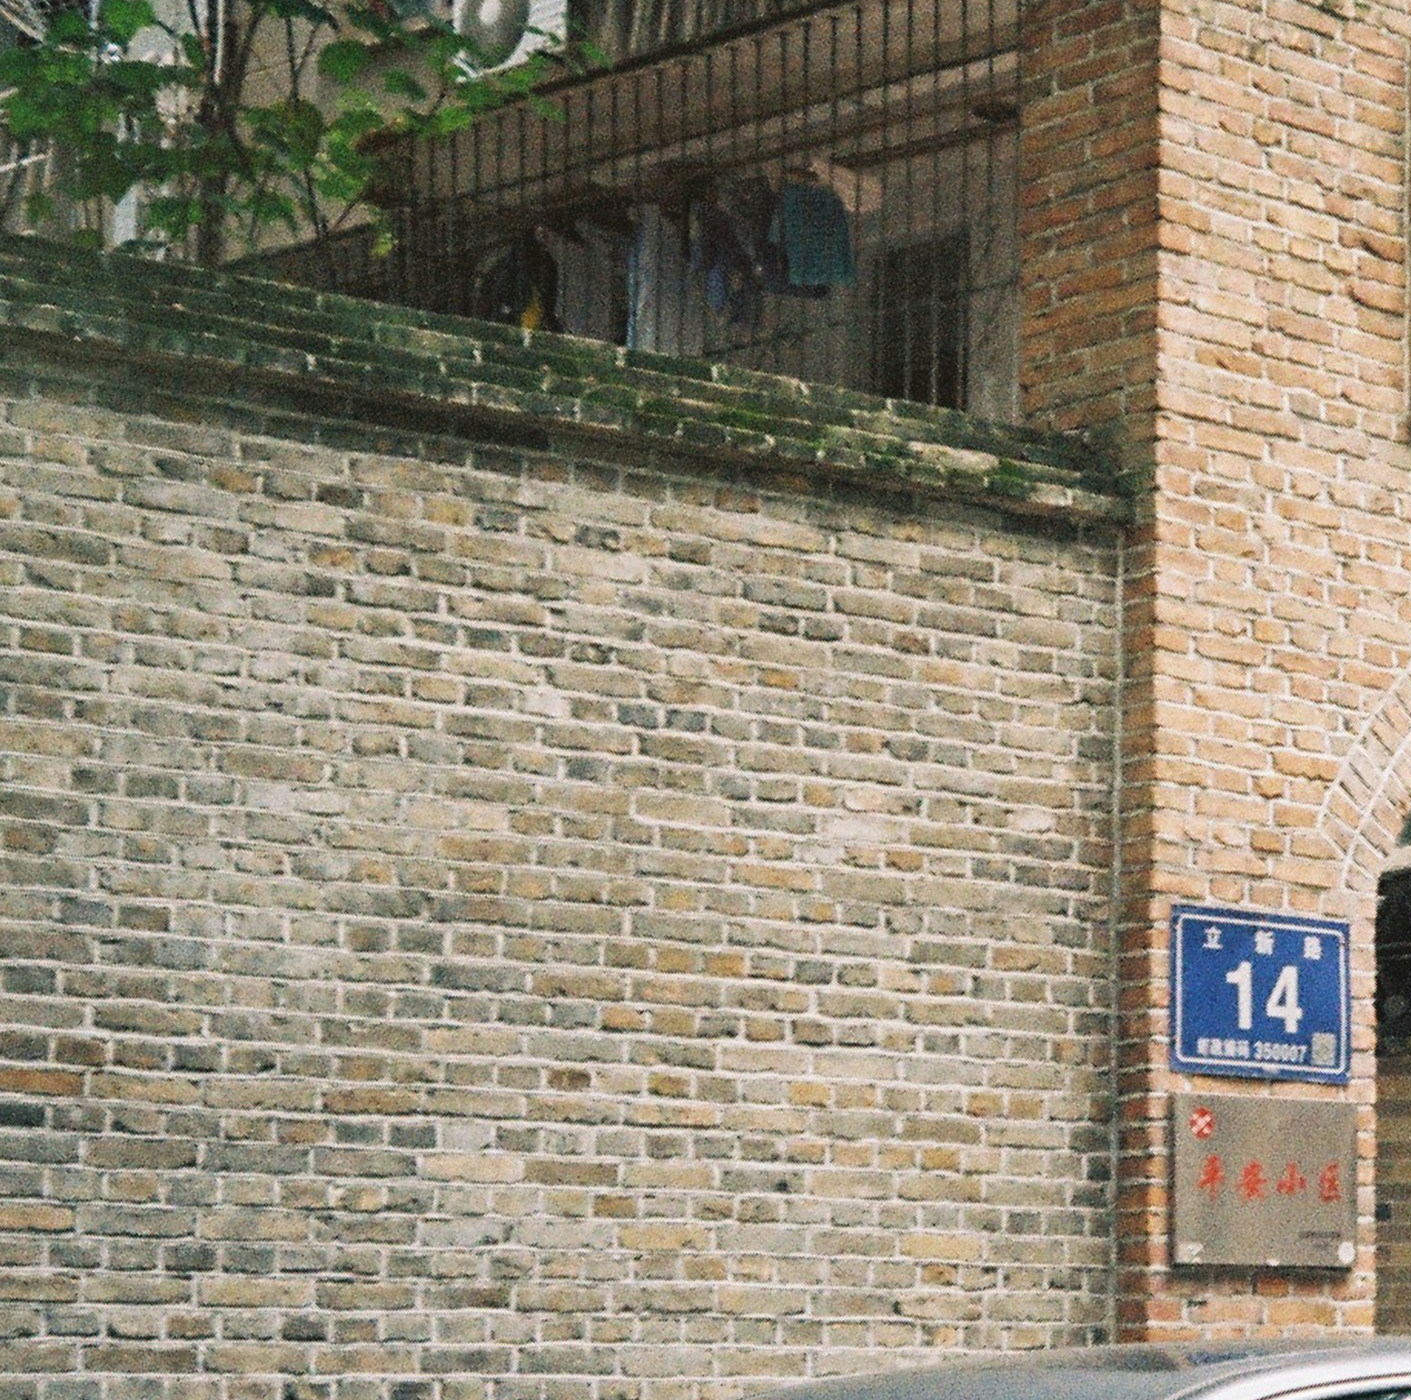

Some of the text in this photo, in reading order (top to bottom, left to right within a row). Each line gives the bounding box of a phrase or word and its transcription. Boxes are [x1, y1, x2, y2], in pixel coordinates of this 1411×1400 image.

[1225, 960, 1303, 1034] 14
[1254, 1040, 1307, 1063] 350007
[1196, 1153, 1342, 1203] 平安小区
